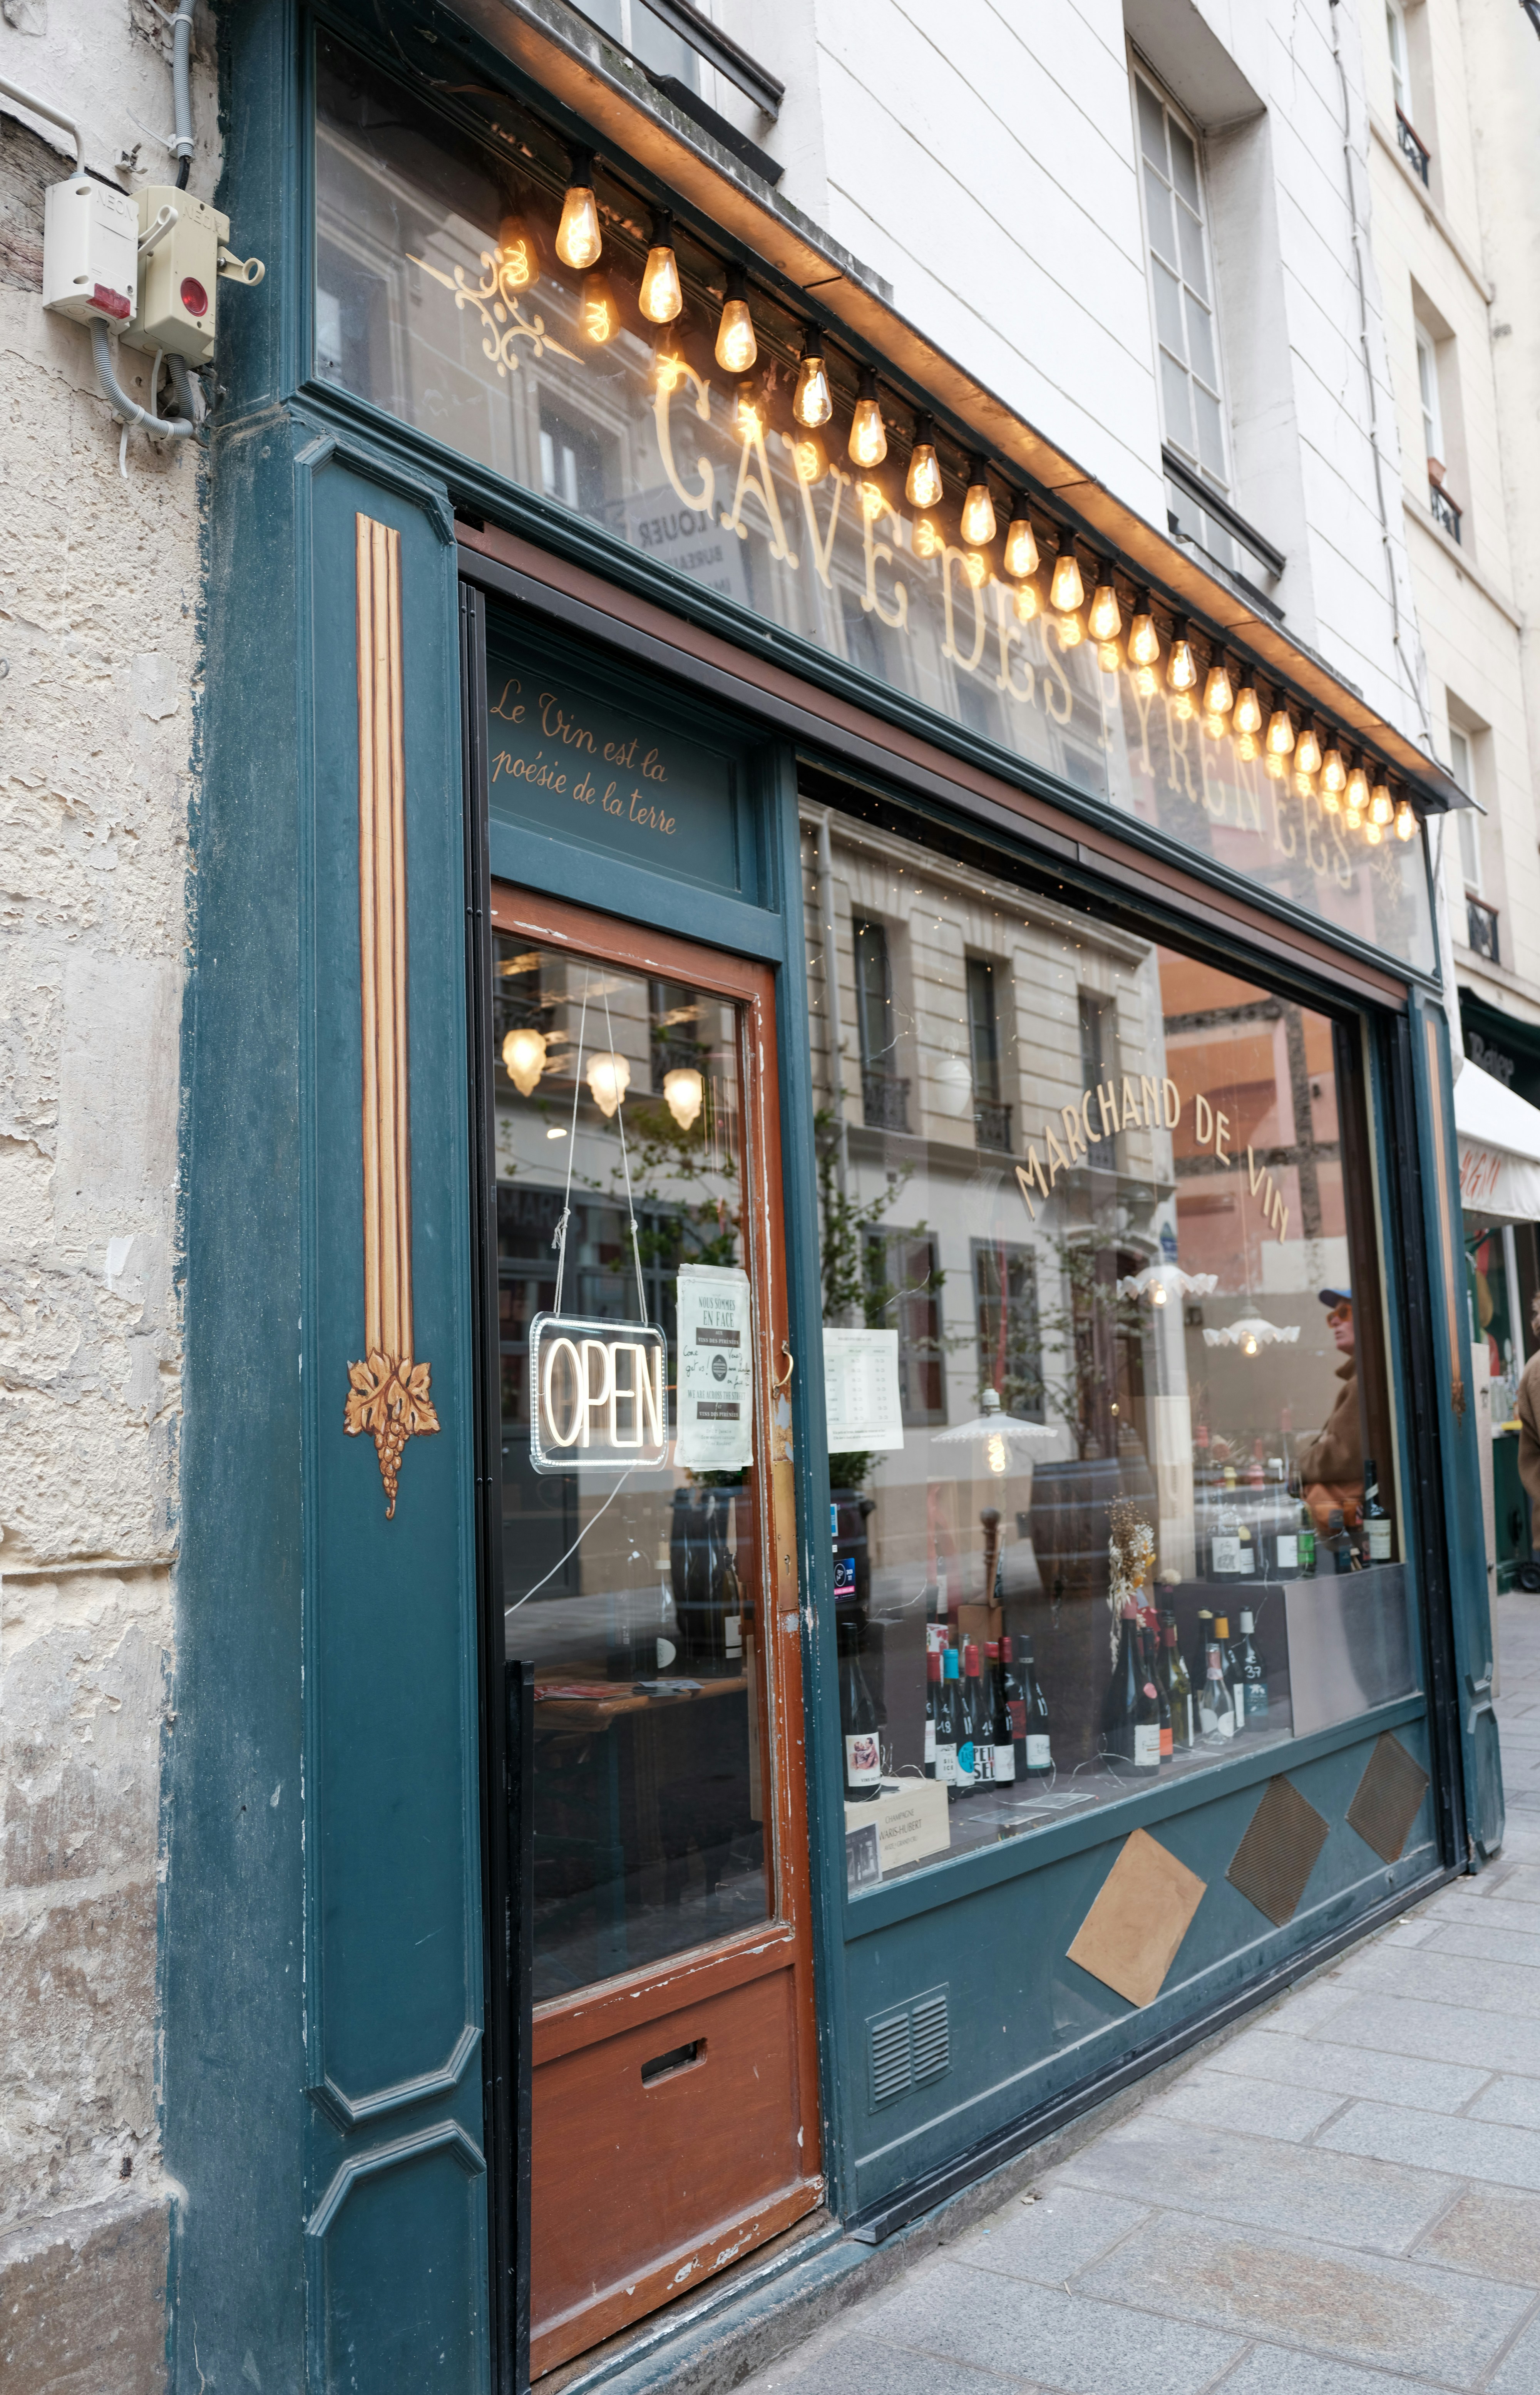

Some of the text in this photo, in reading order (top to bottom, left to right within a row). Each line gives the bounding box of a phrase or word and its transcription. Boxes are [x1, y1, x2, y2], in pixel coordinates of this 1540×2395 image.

[97, 188, 134, 221] NEON
[652, 358, 910, 636] CAVE
[935, 536, 1073, 725] DES
[490, 679, 668, 782] Le Vin est la
[491, 750, 676, 835] poésie de la terre
[1014, 1074, 1289, 1244] MARCHAND DE VIN
[699, 1296, 735, 1310] NOUS SOMMES
[703, 1311, 734, 1327] EN FACE
[683, 1345, 698, 1356] Come
[686, 1359, 699, 1377] get
[544, 1338, 663, 1448] OPEN
[688, 1390, 695, 1398] WE
[696, 1390, 705, 1399] ARE
[707, 1390, 722, 1399] ACROSS
[732, 1392, 745, 1400] STREET
[936, 1720, 952, 1733] 18
[885, 1808, 914, 1824] CHAMPAGNE
